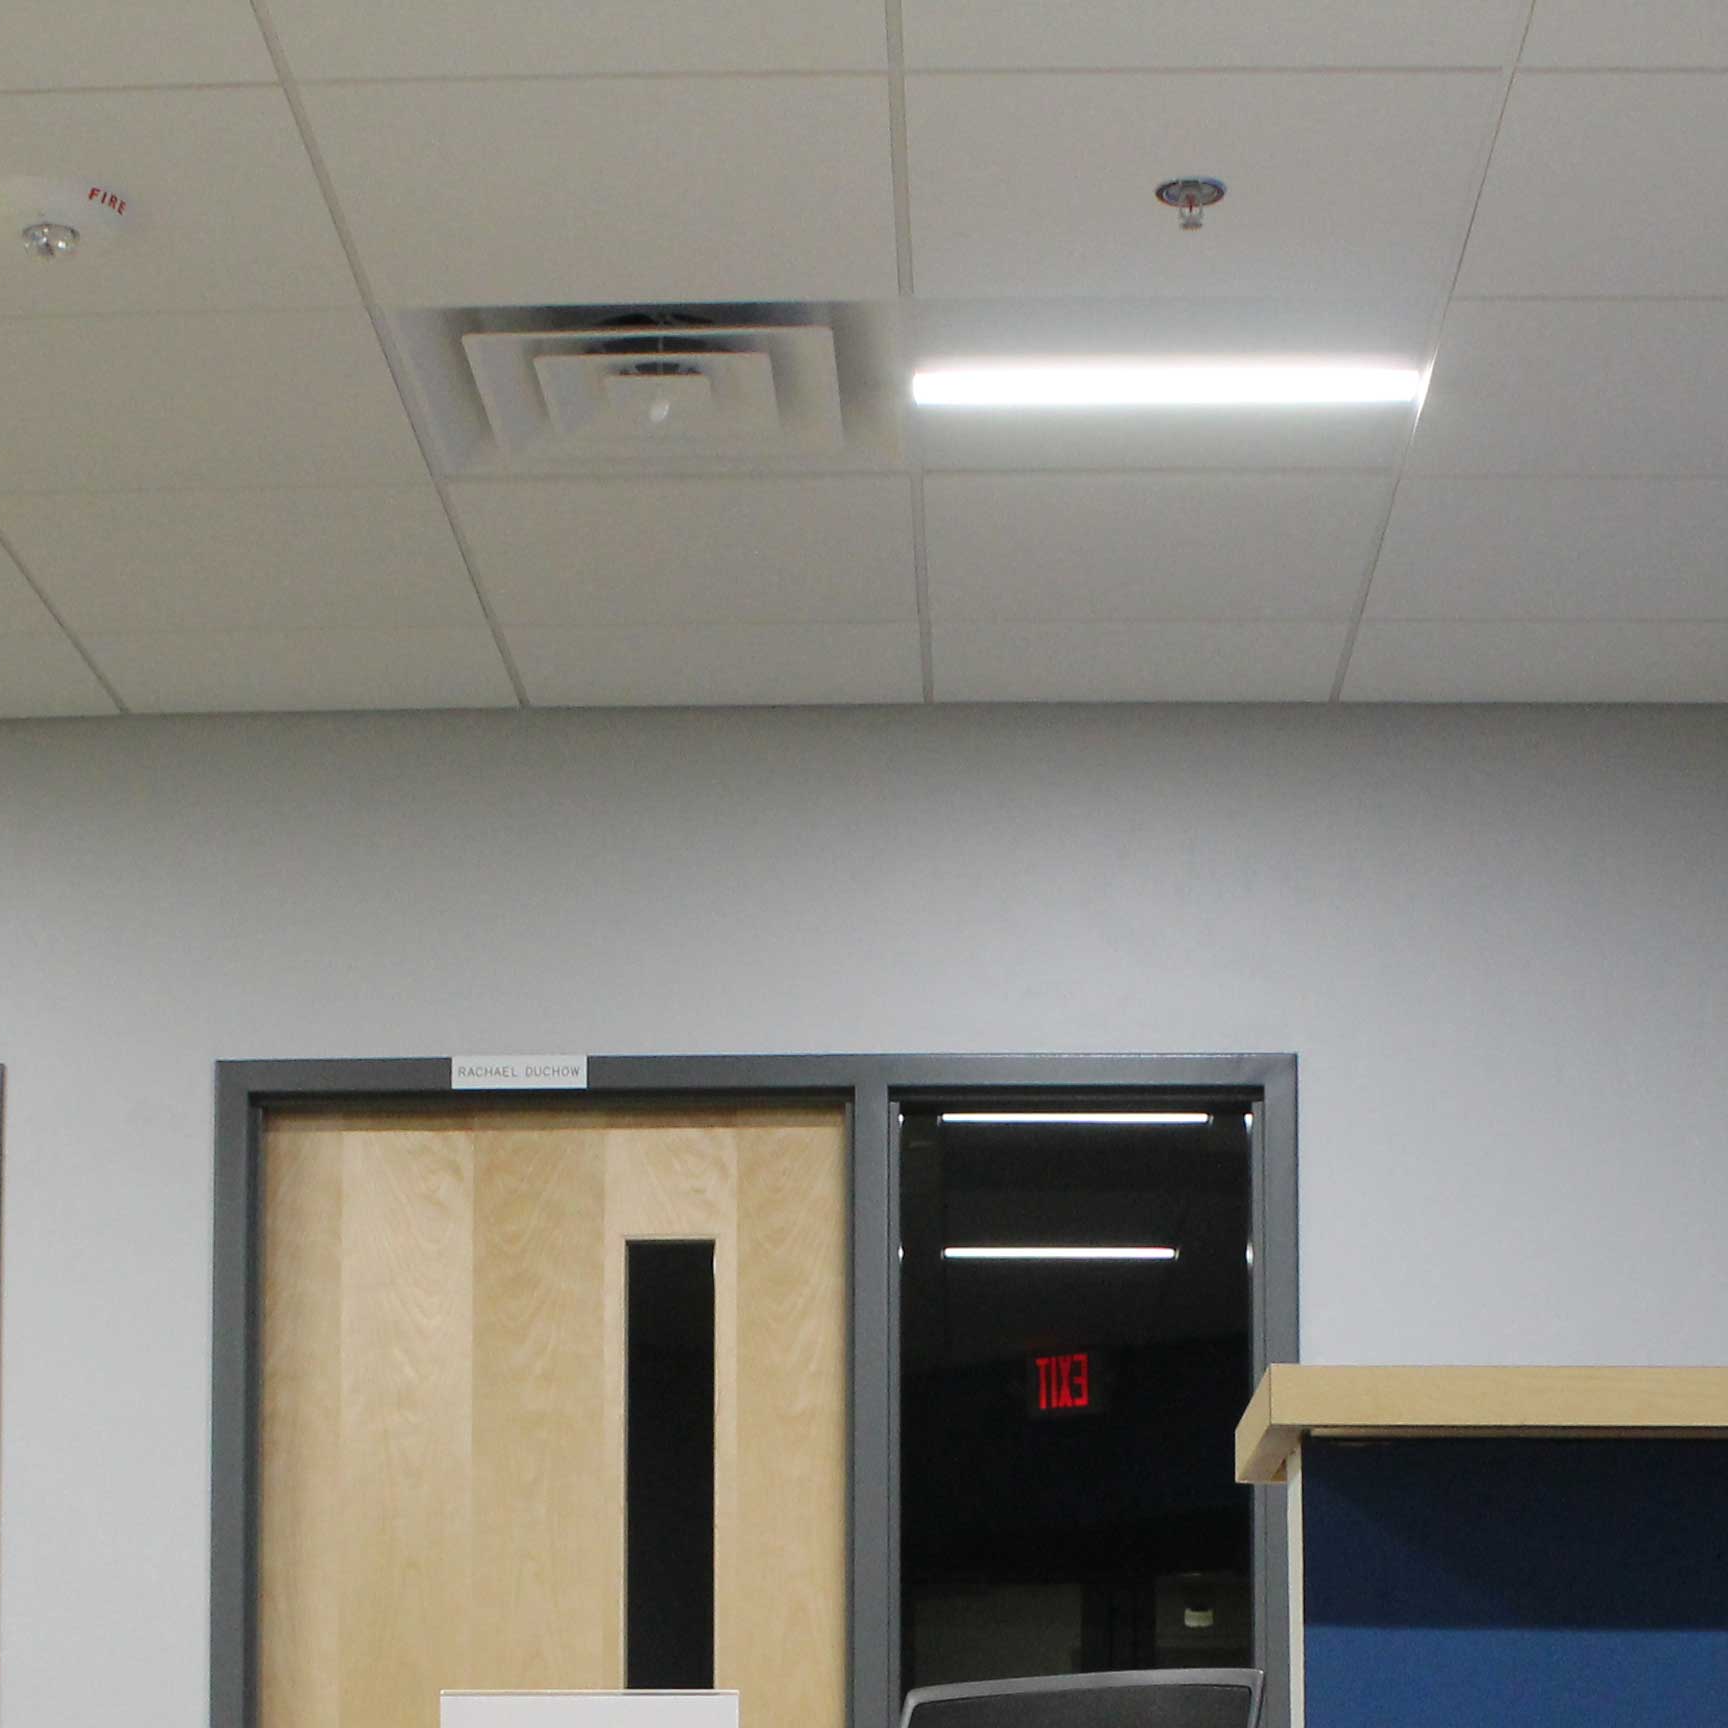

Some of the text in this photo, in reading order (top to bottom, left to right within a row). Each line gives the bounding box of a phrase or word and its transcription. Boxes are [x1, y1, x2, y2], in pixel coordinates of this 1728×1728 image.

[88, 187, 126, 216] FIRE
[458, 1066, 580, 1078] RACHAEL DUCHOW
